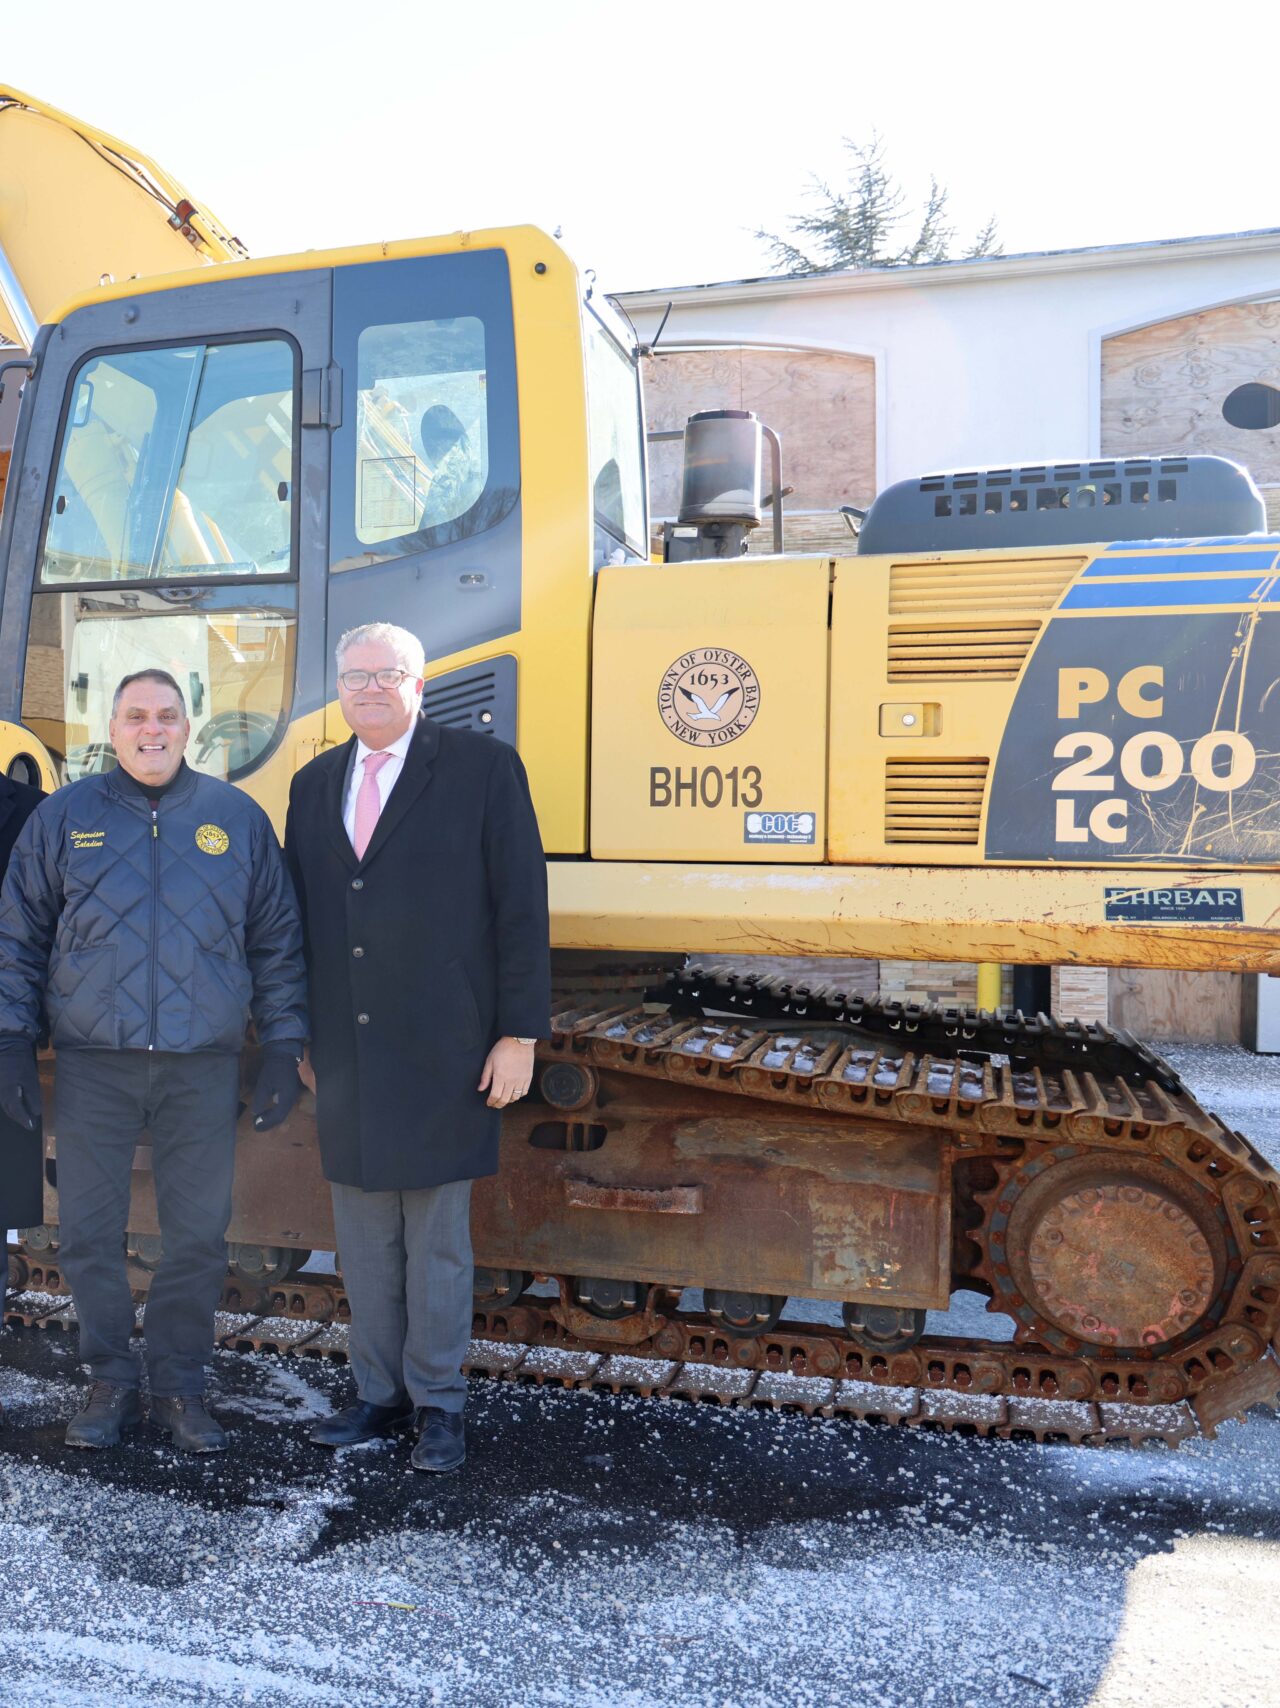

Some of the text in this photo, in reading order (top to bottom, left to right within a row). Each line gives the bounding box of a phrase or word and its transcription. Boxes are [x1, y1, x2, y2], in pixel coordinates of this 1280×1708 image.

[660, 650, 757, 713] TOWN OF OYSTER BAY
[690, 668, 729, 690] 1653
[1058, 665, 1164, 719] PC
[670, 719, 746, 744] NEW YORK
[1051, 730, 1256, 792] 200
[649, 765, 763, 808] BH013
[1055, 798, 1128, 844] LC
[1109, 889, 1238, 906] EHRBAR
